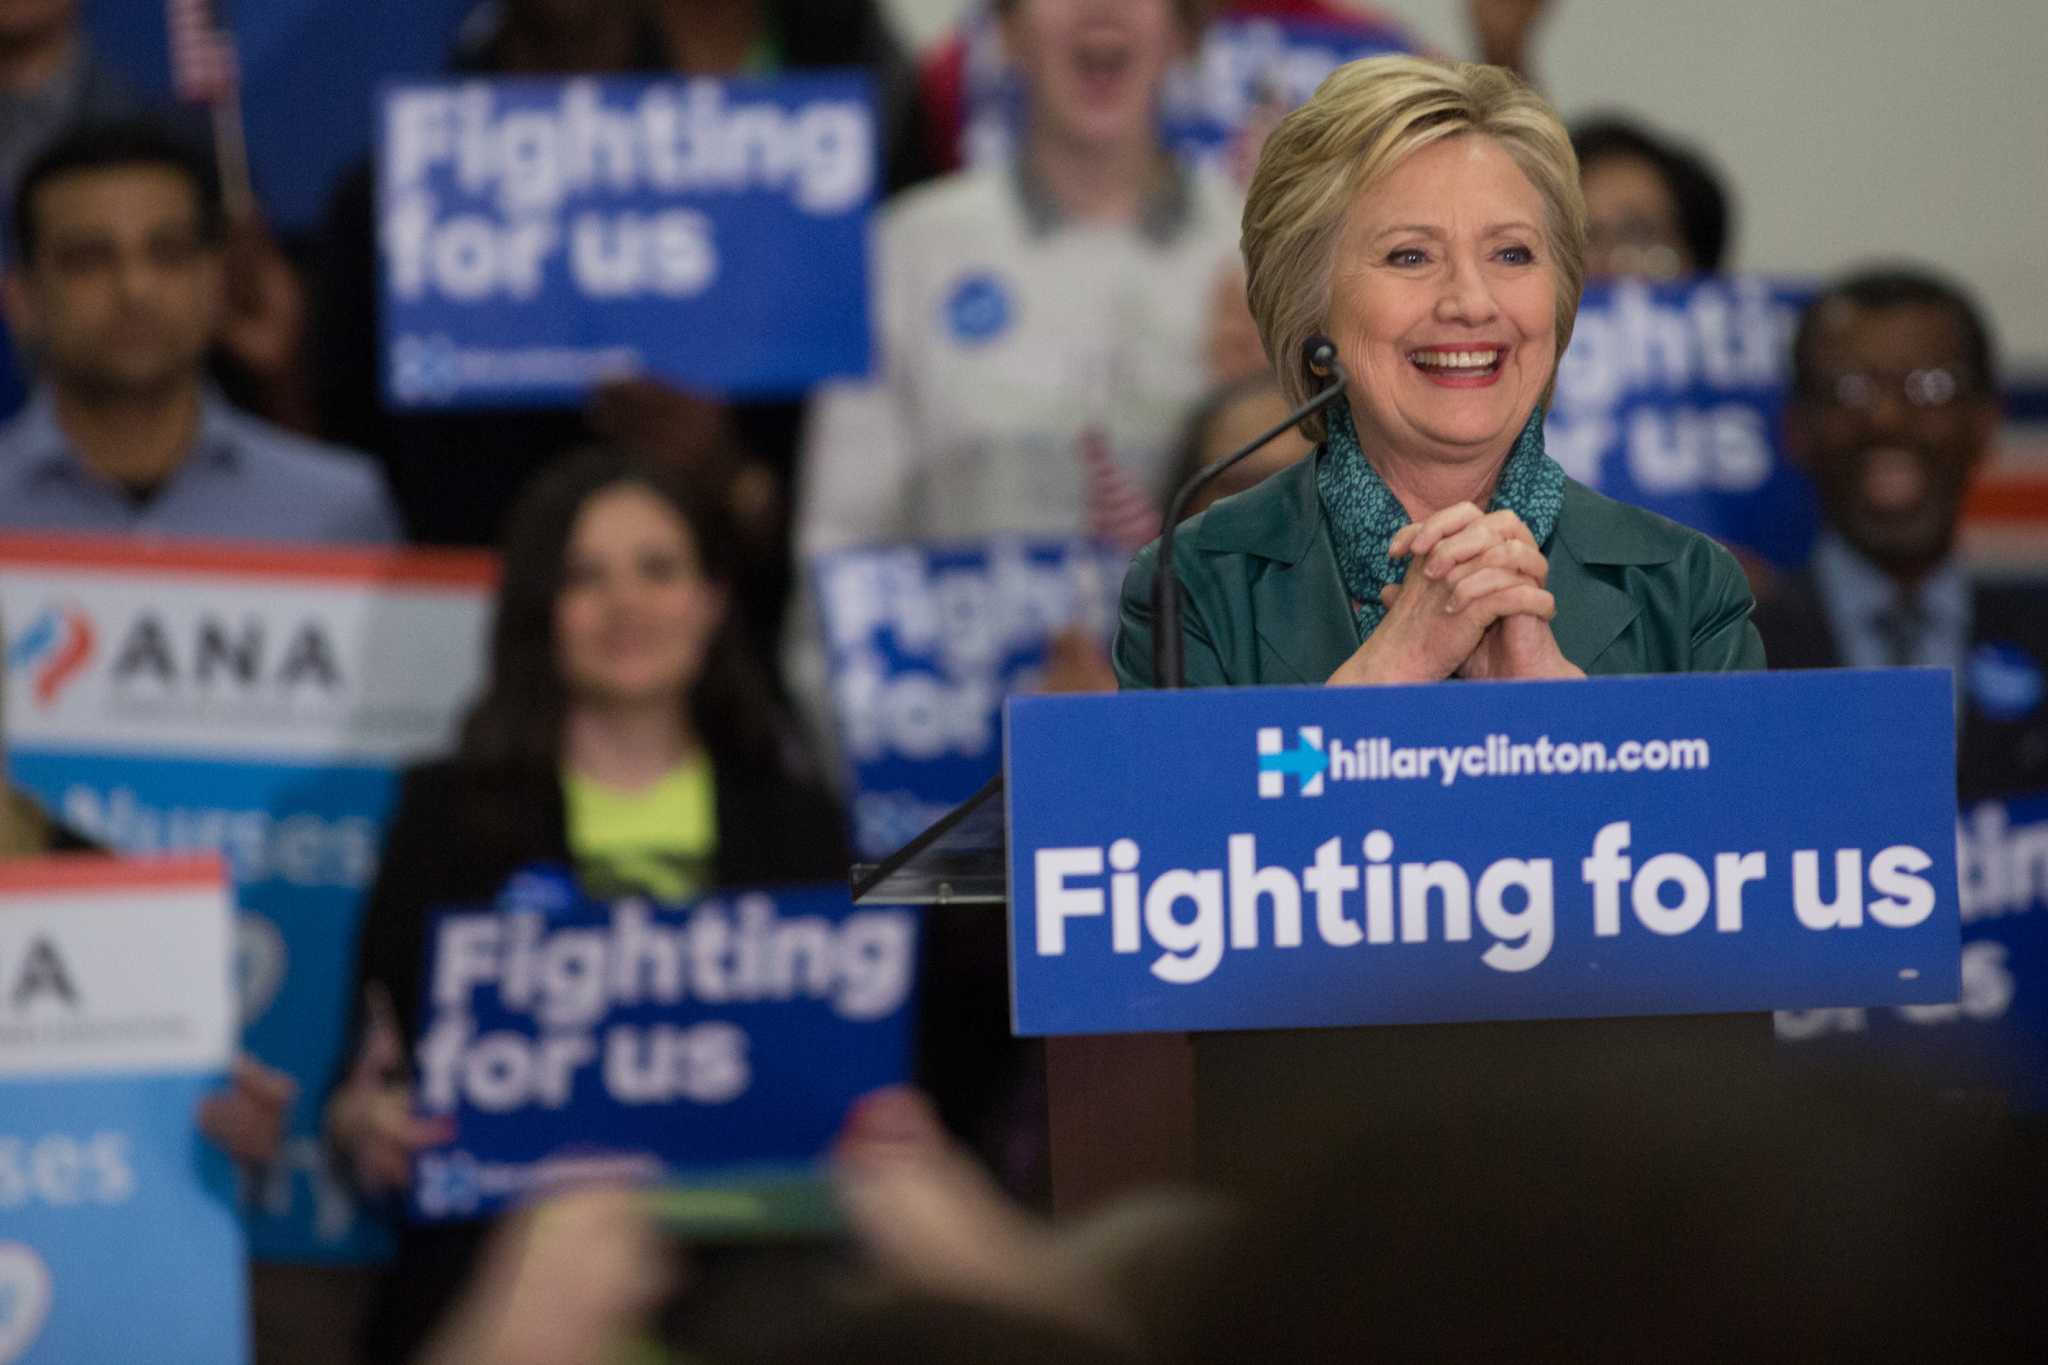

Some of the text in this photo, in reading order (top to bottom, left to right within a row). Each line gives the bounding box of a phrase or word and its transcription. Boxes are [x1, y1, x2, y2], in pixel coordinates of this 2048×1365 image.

[387, 76, 875, 214] Fighting
[384, 190, 716, 301] for us
[1628, 403, 1775, 496] us
[110, 606, 347, 692] ANA
[1330, 733, 1710, 787] hillaryclinton.com
[1034, 829, 1554, 985] Fighting
[1582, 820, 1767, 937] for
[1792, 844, 1936, 931] us
[433, 894, 916, 1021] Fighting
[417, 1008, 751, 1112] for us
